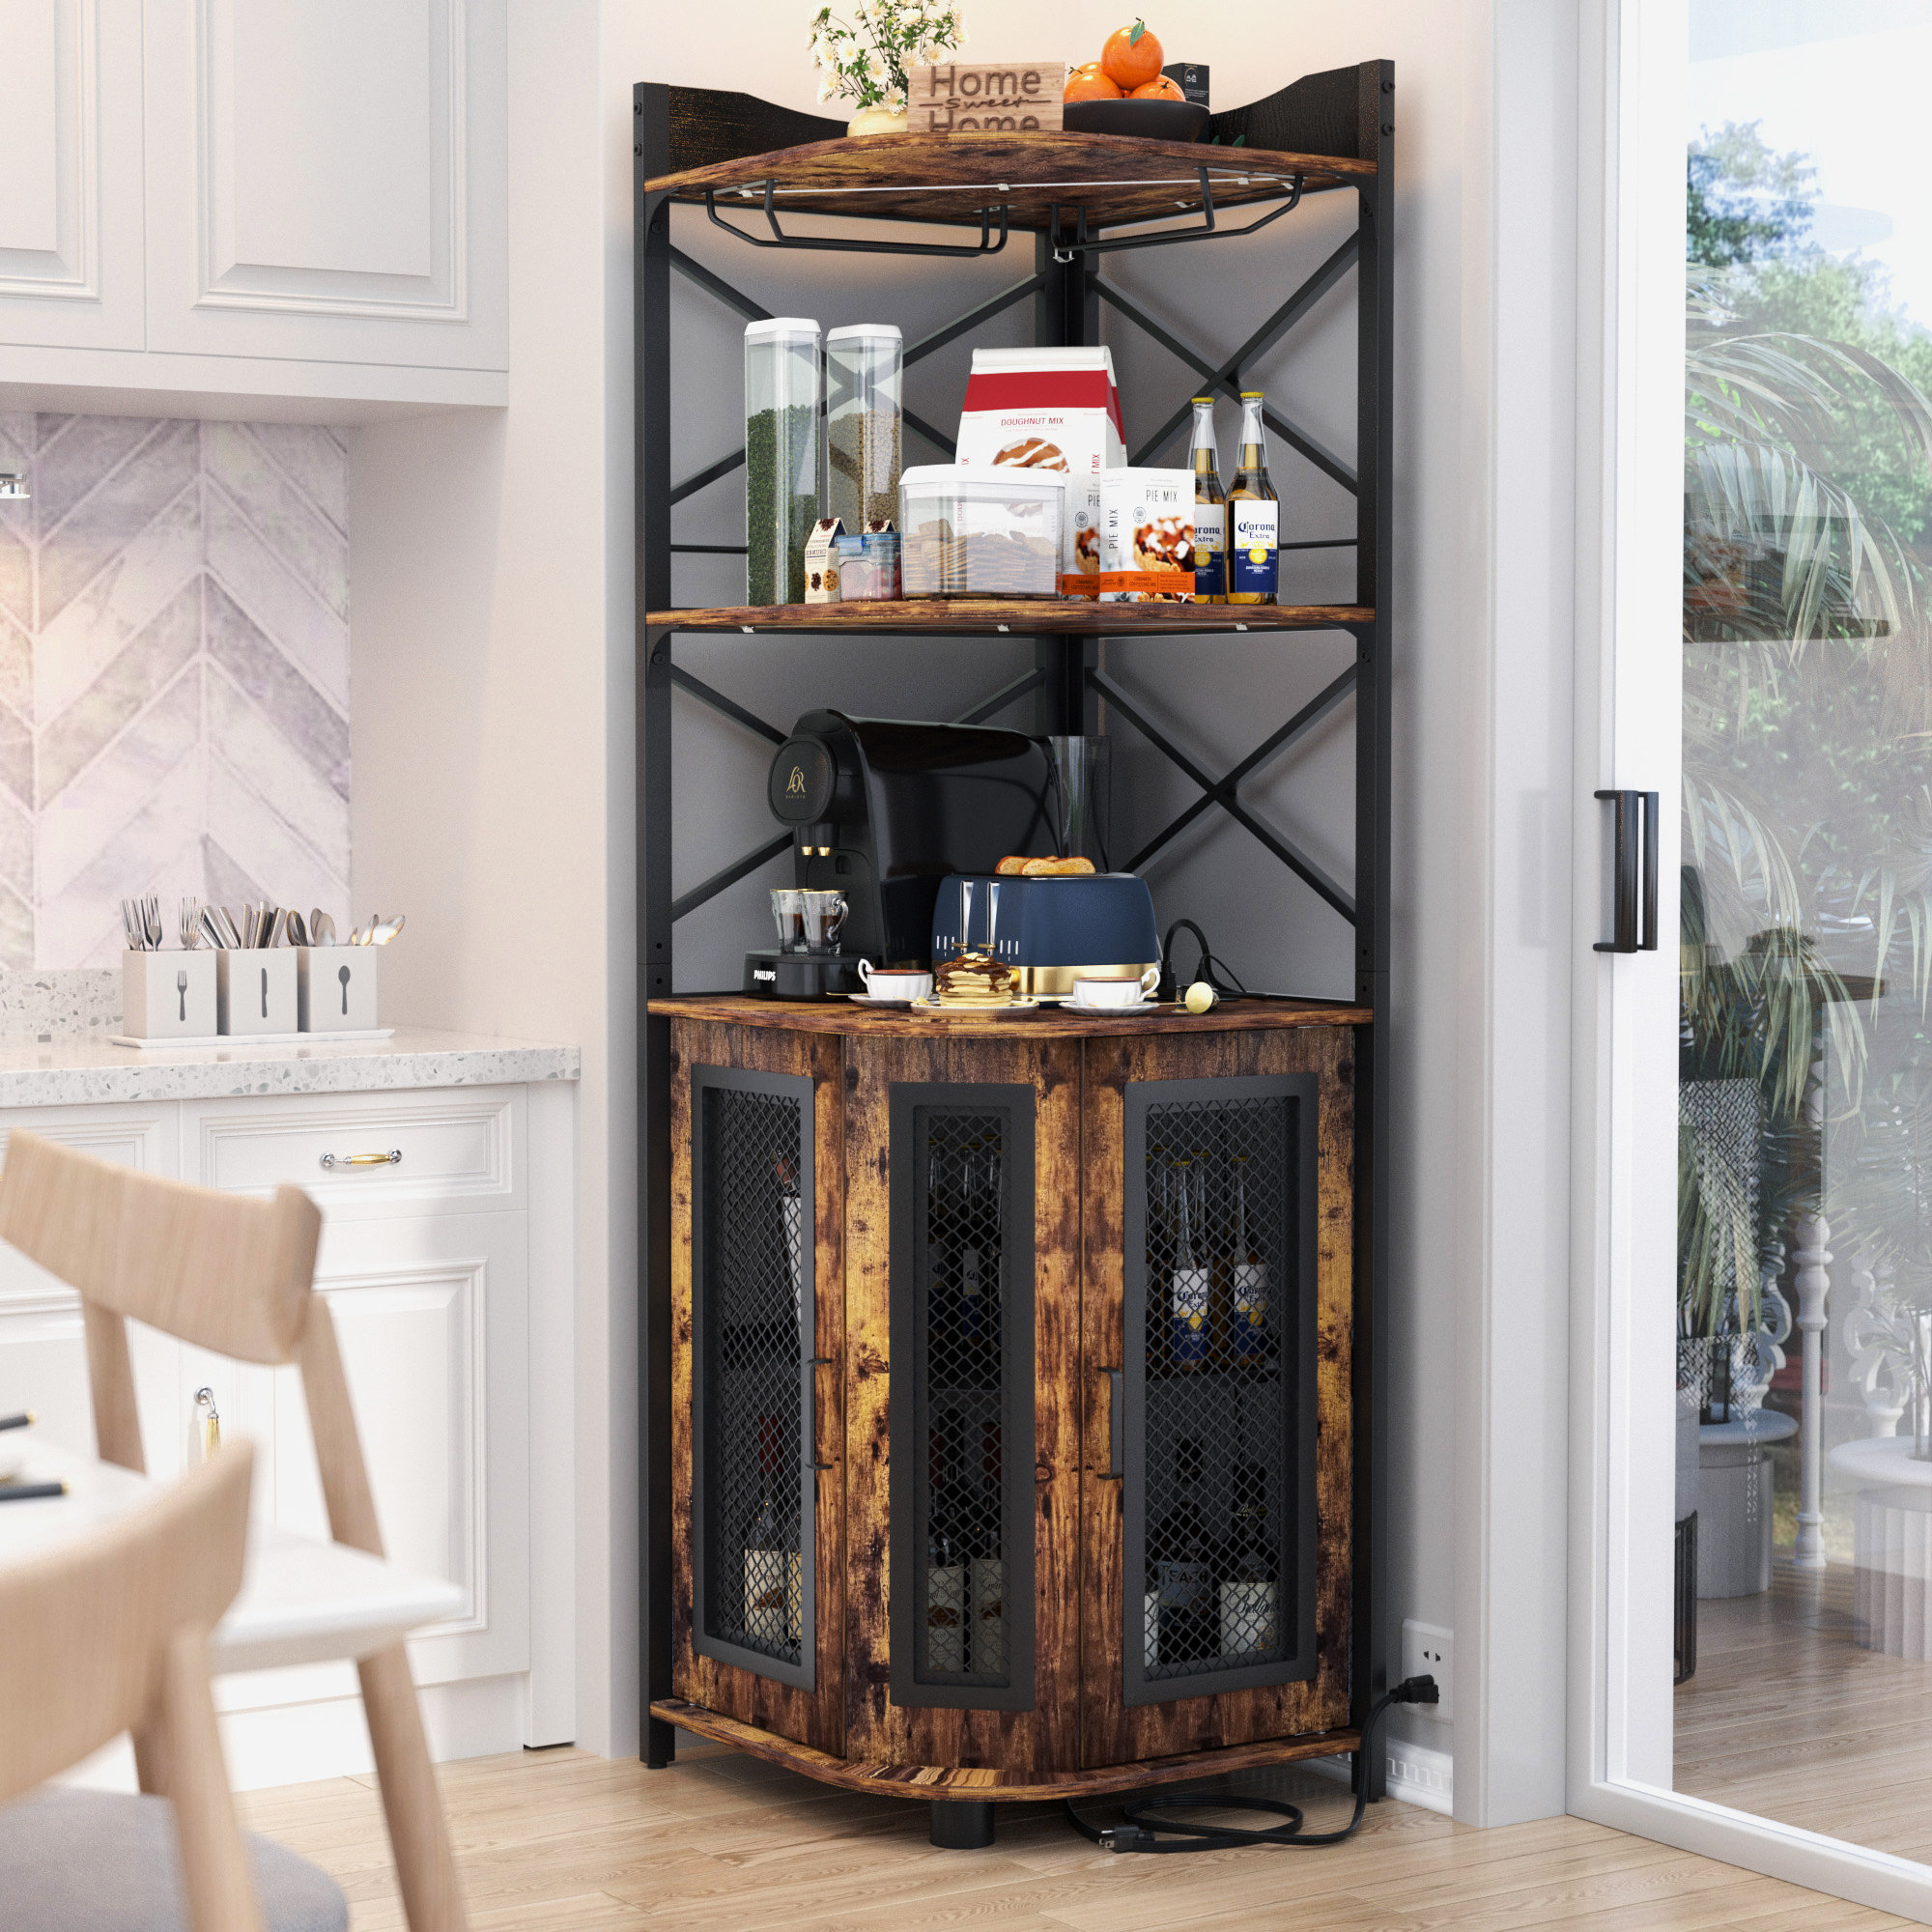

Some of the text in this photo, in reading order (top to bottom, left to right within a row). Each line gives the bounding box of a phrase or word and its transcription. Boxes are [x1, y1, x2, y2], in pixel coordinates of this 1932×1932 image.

[929, 65, 1041, 97] Home
[945, 96, 1030, 110] Sweet
[1001, 416, 1065, 426] DOUGHNUT MIX
[1088, 494, 1100, 507] PIE
[1146, 489, 1178, 502] PIE MIX
[1108, 508, 1119, 549] PIE MIX
[1237, 521, 1275, 533] Corona
[753, 969, 777, 981] PHILIPS
